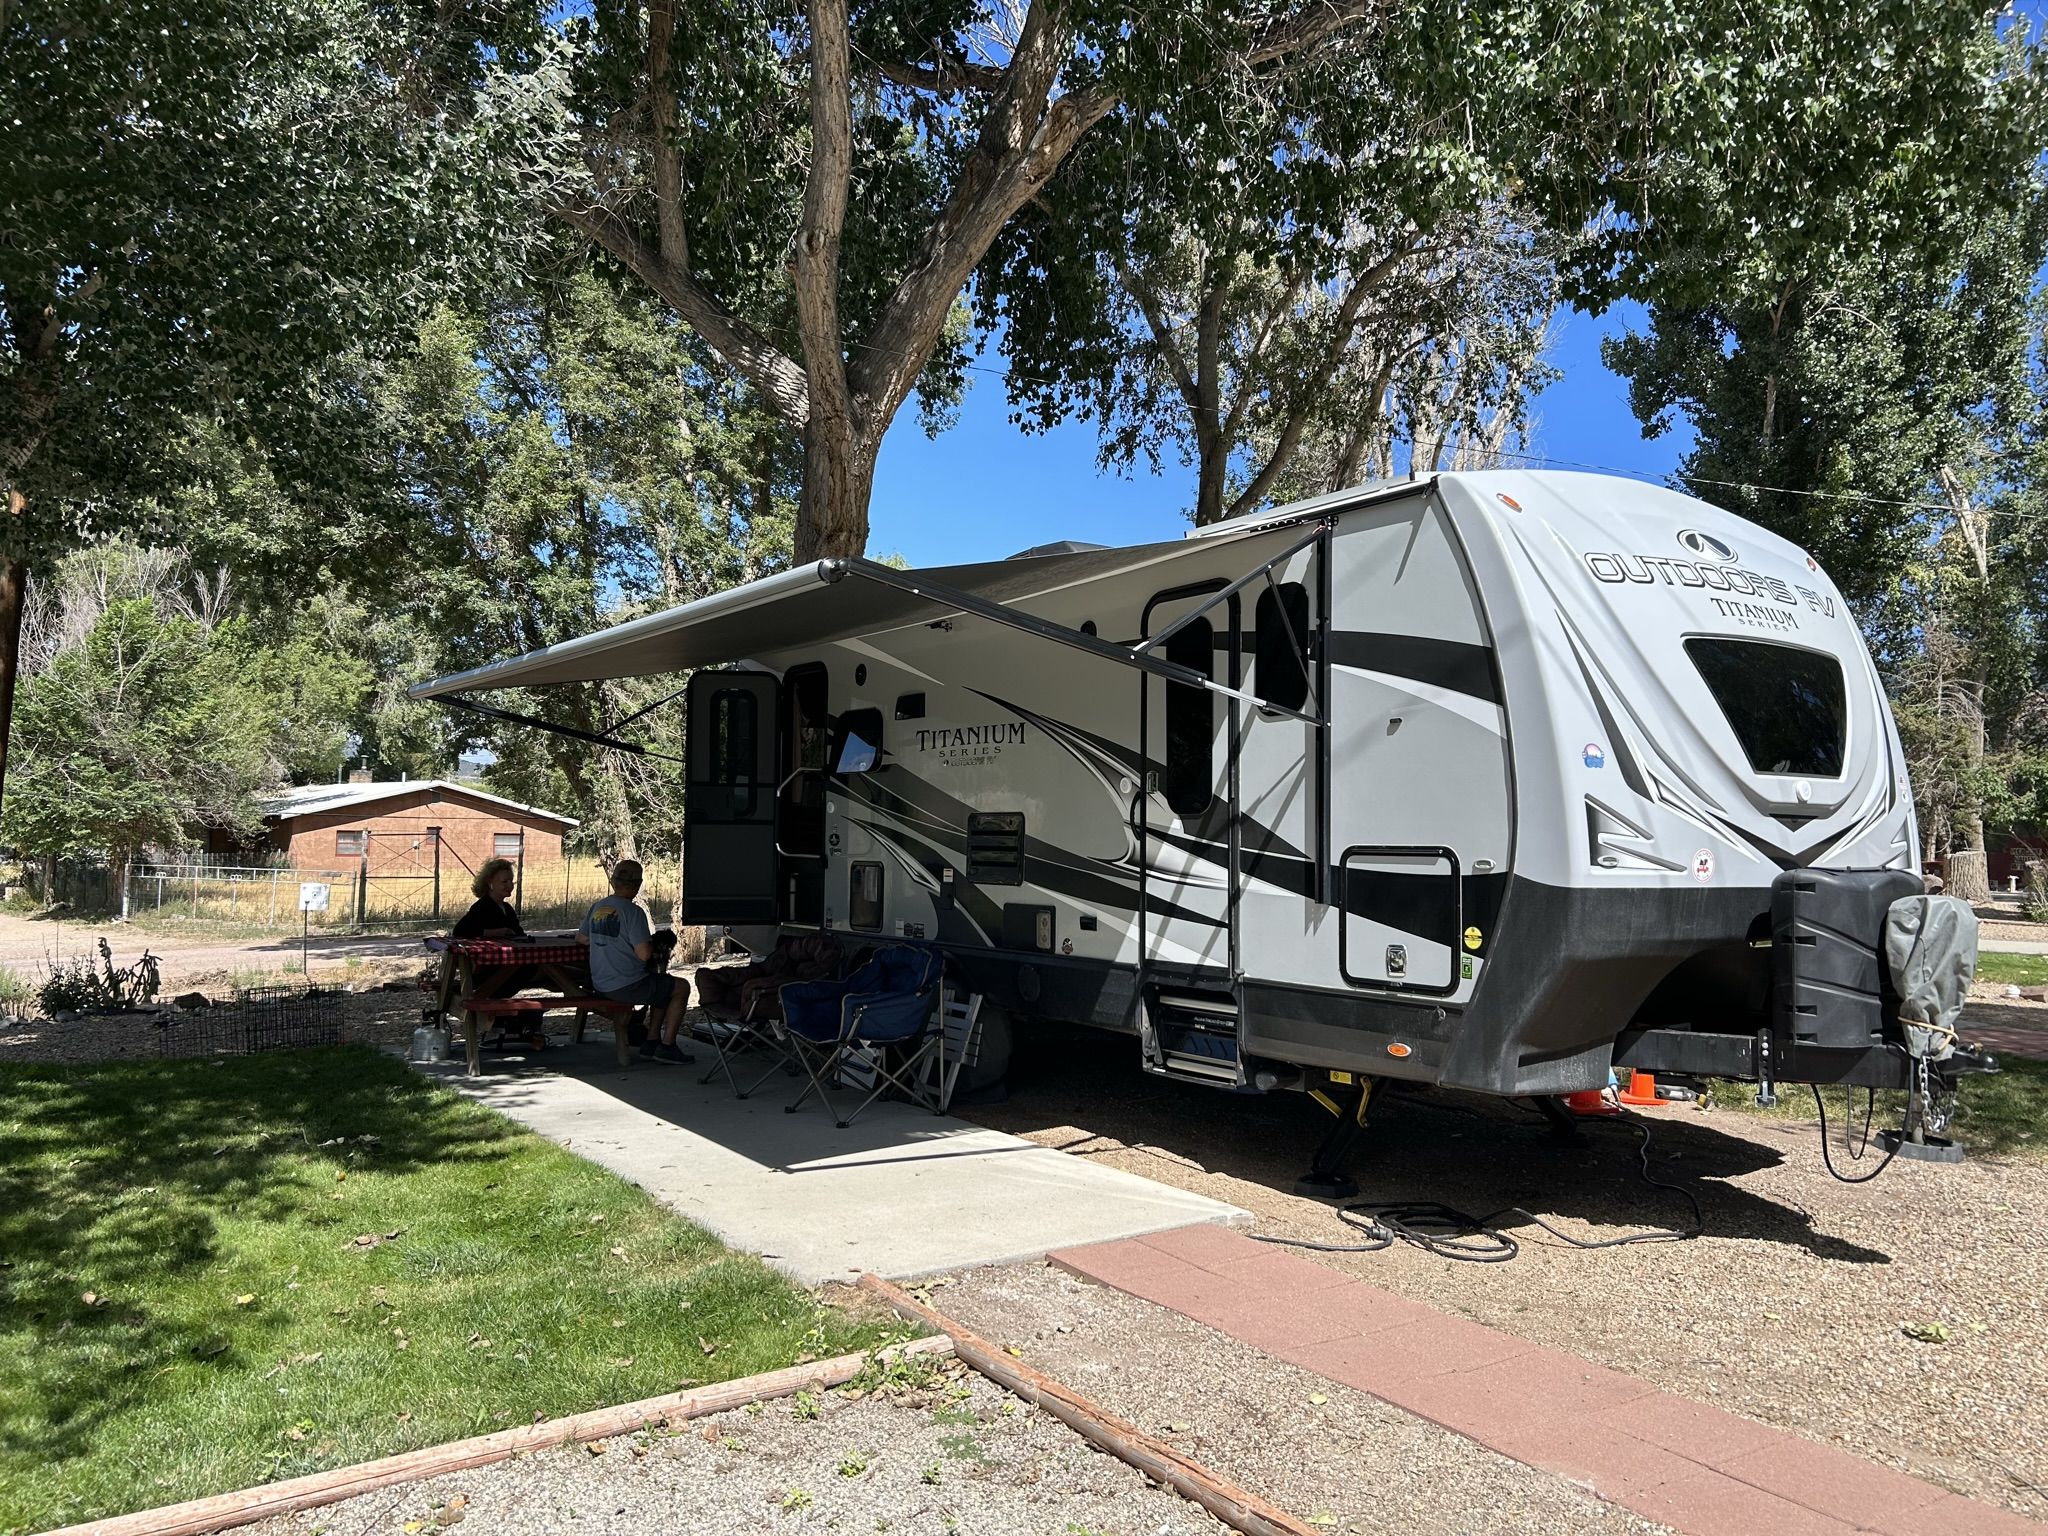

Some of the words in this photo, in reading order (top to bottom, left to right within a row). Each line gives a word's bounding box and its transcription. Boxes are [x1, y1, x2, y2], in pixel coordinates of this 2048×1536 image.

[1584, 552, 1798, 606] OUTDOORS
[1795, 585, 1836, 619] RV
[1710, 597, 1800, 630] TITANIUM
[1738, 618, 1790, 632] SERIES
[916, 722, 1026, 751] TITANIUM
[939, 746, 1002, 758] SERIES
